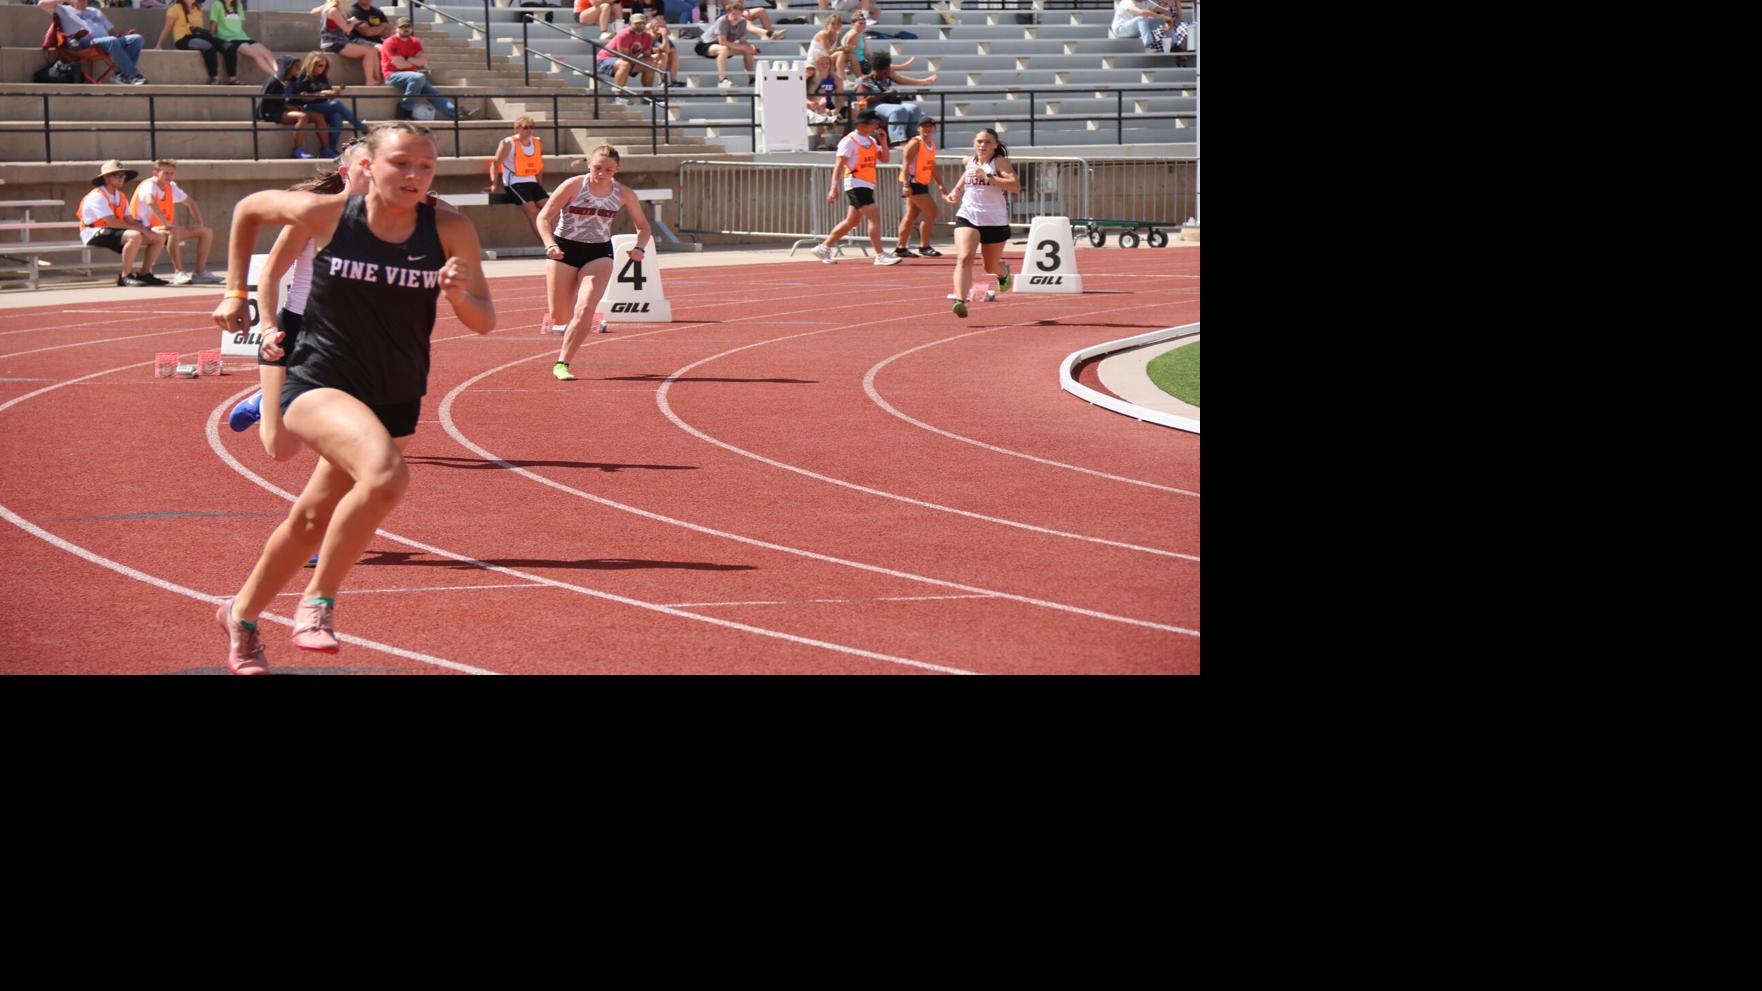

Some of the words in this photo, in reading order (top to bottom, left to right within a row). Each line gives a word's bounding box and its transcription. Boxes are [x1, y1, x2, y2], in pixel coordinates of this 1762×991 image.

[1036, 239, 1061, 272] 3
[329, 257, 379, 282] PINE
[385, 265, 439, 289] VIEW
[617, 257, 647, 291] 4
[1029, 276, 1063, 285] GILL
[610, 302, 650, 313] GILL
